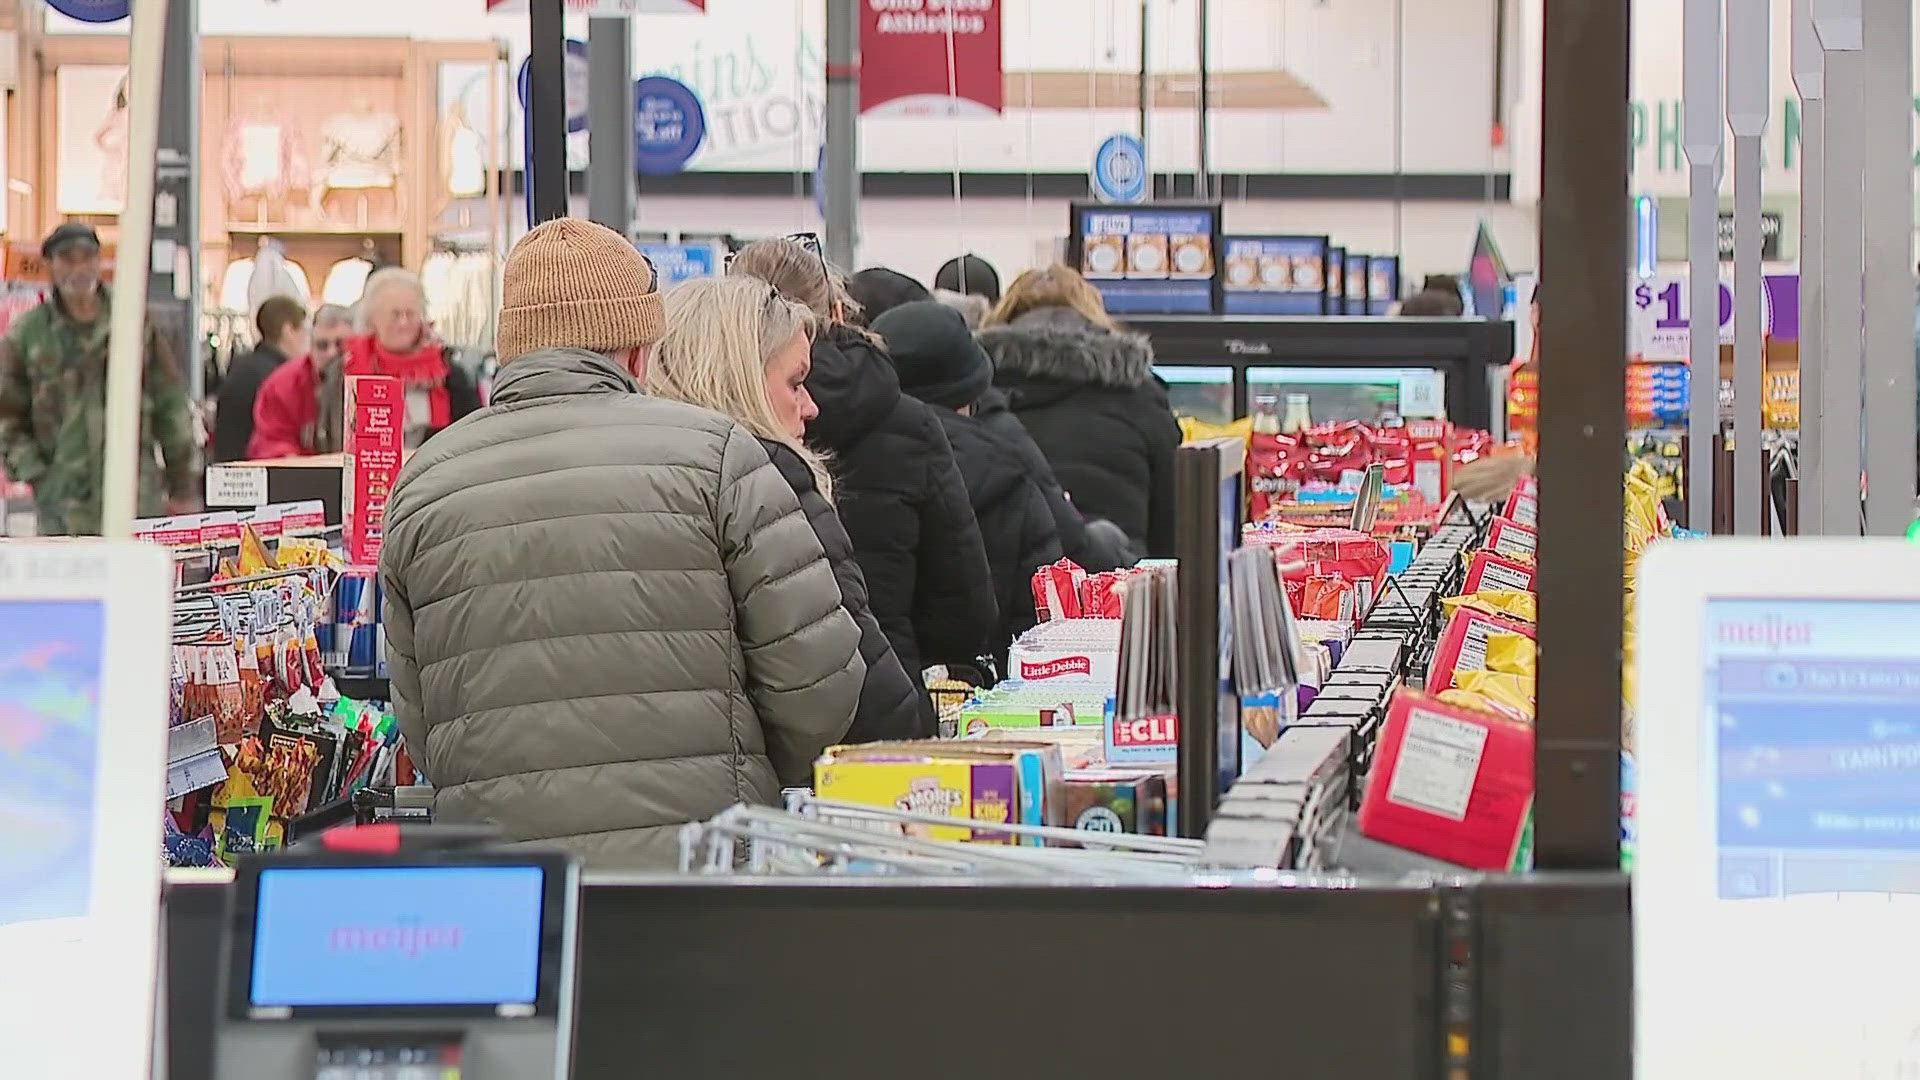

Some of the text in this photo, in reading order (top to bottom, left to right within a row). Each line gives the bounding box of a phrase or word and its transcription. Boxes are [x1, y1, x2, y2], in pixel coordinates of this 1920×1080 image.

[875, 11, 986, 34] Athletics
[1486, 562, 1530, 580] Nutrition Facts
[1471, 620, 1503, 635] Nutrition
[1023, 659, 1087, 677] Little Debbie
